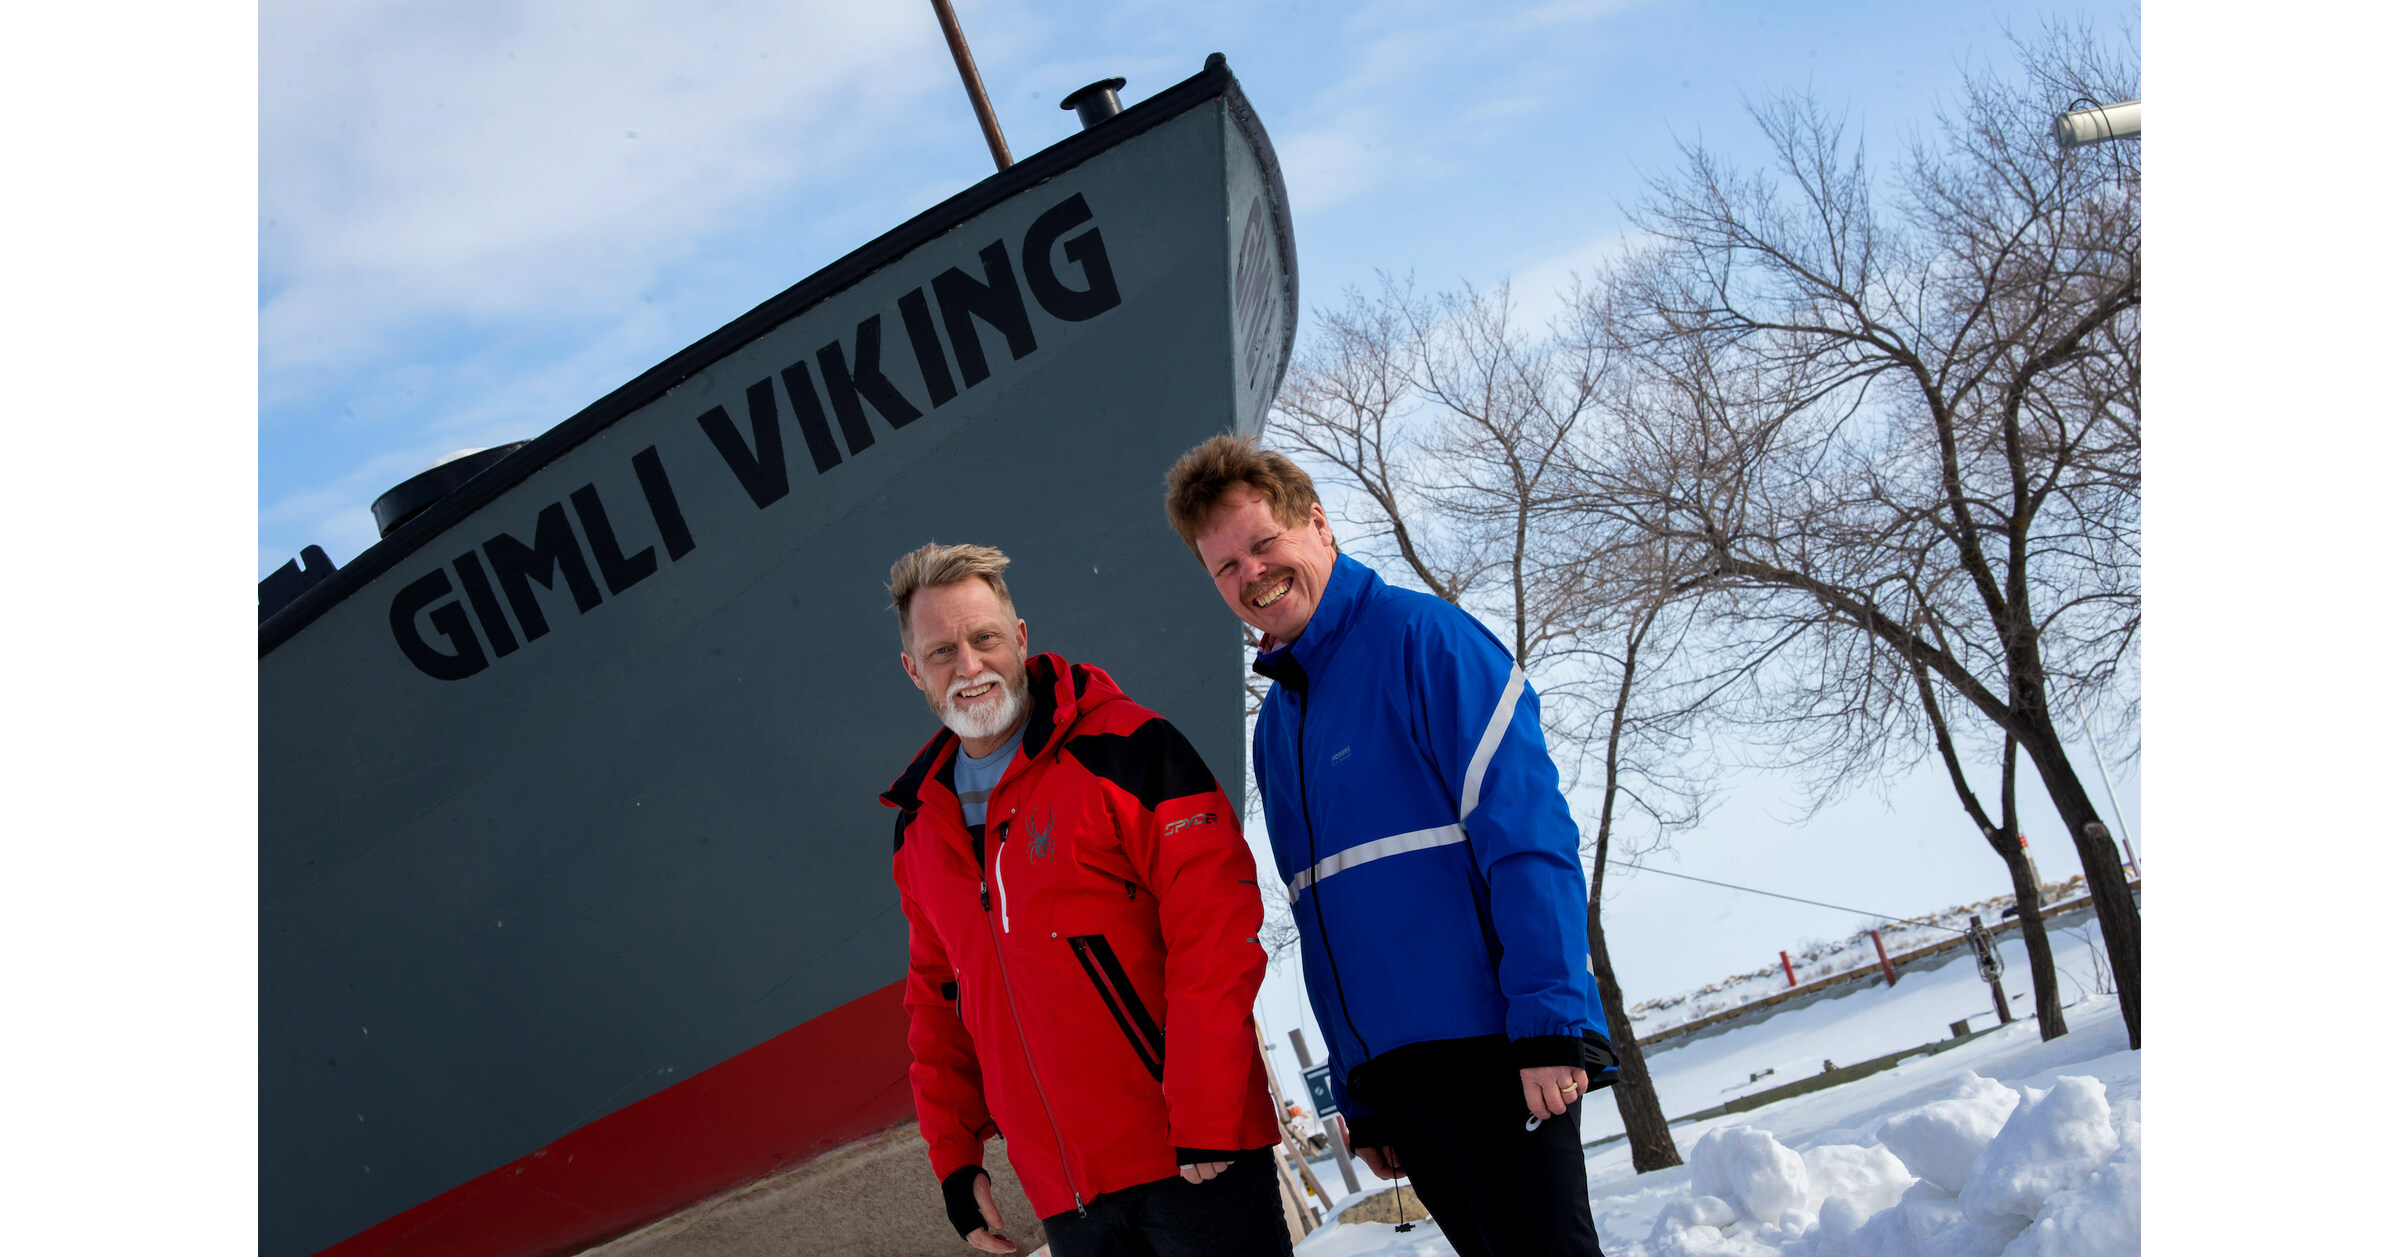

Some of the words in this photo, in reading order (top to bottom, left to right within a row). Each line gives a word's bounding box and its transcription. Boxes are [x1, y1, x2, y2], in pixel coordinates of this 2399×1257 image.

[389, 445, 696, 681] GIMLI
[696, 192, 1122, 510] VIKING
[1164, 812, 1219, 836] SPYDER
